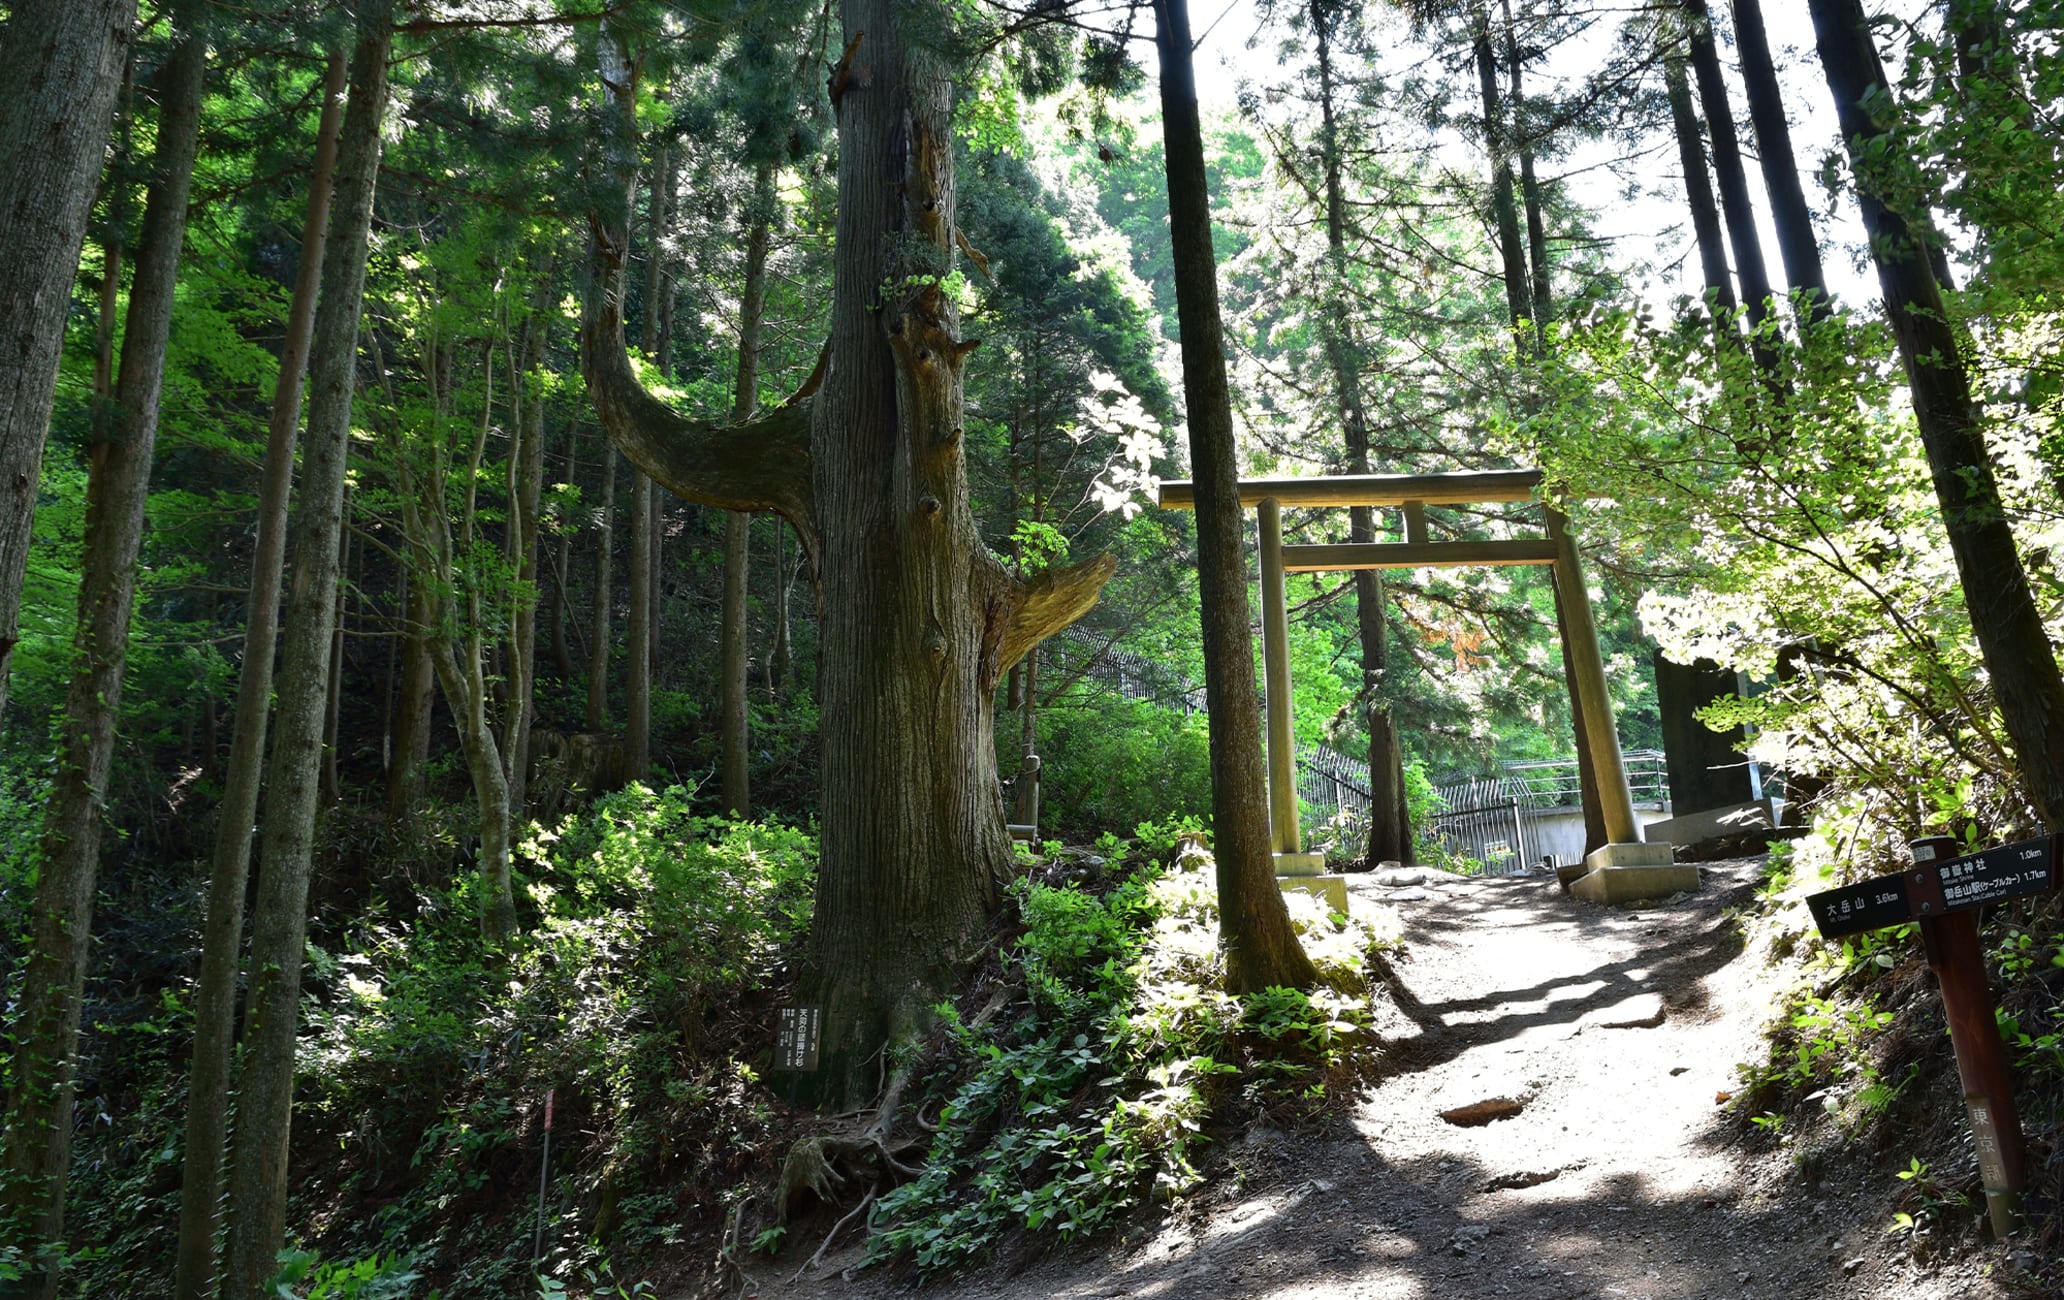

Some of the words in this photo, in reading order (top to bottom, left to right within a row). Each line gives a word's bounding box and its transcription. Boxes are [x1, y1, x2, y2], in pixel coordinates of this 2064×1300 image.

[2019, 848, 2042, 861] 1.0km
[2024, 869, 2047, 882] 1.7km
[1875, 891, 1899, 905] 3.6km
[1827, 896, 1865, 917] 大岳山
